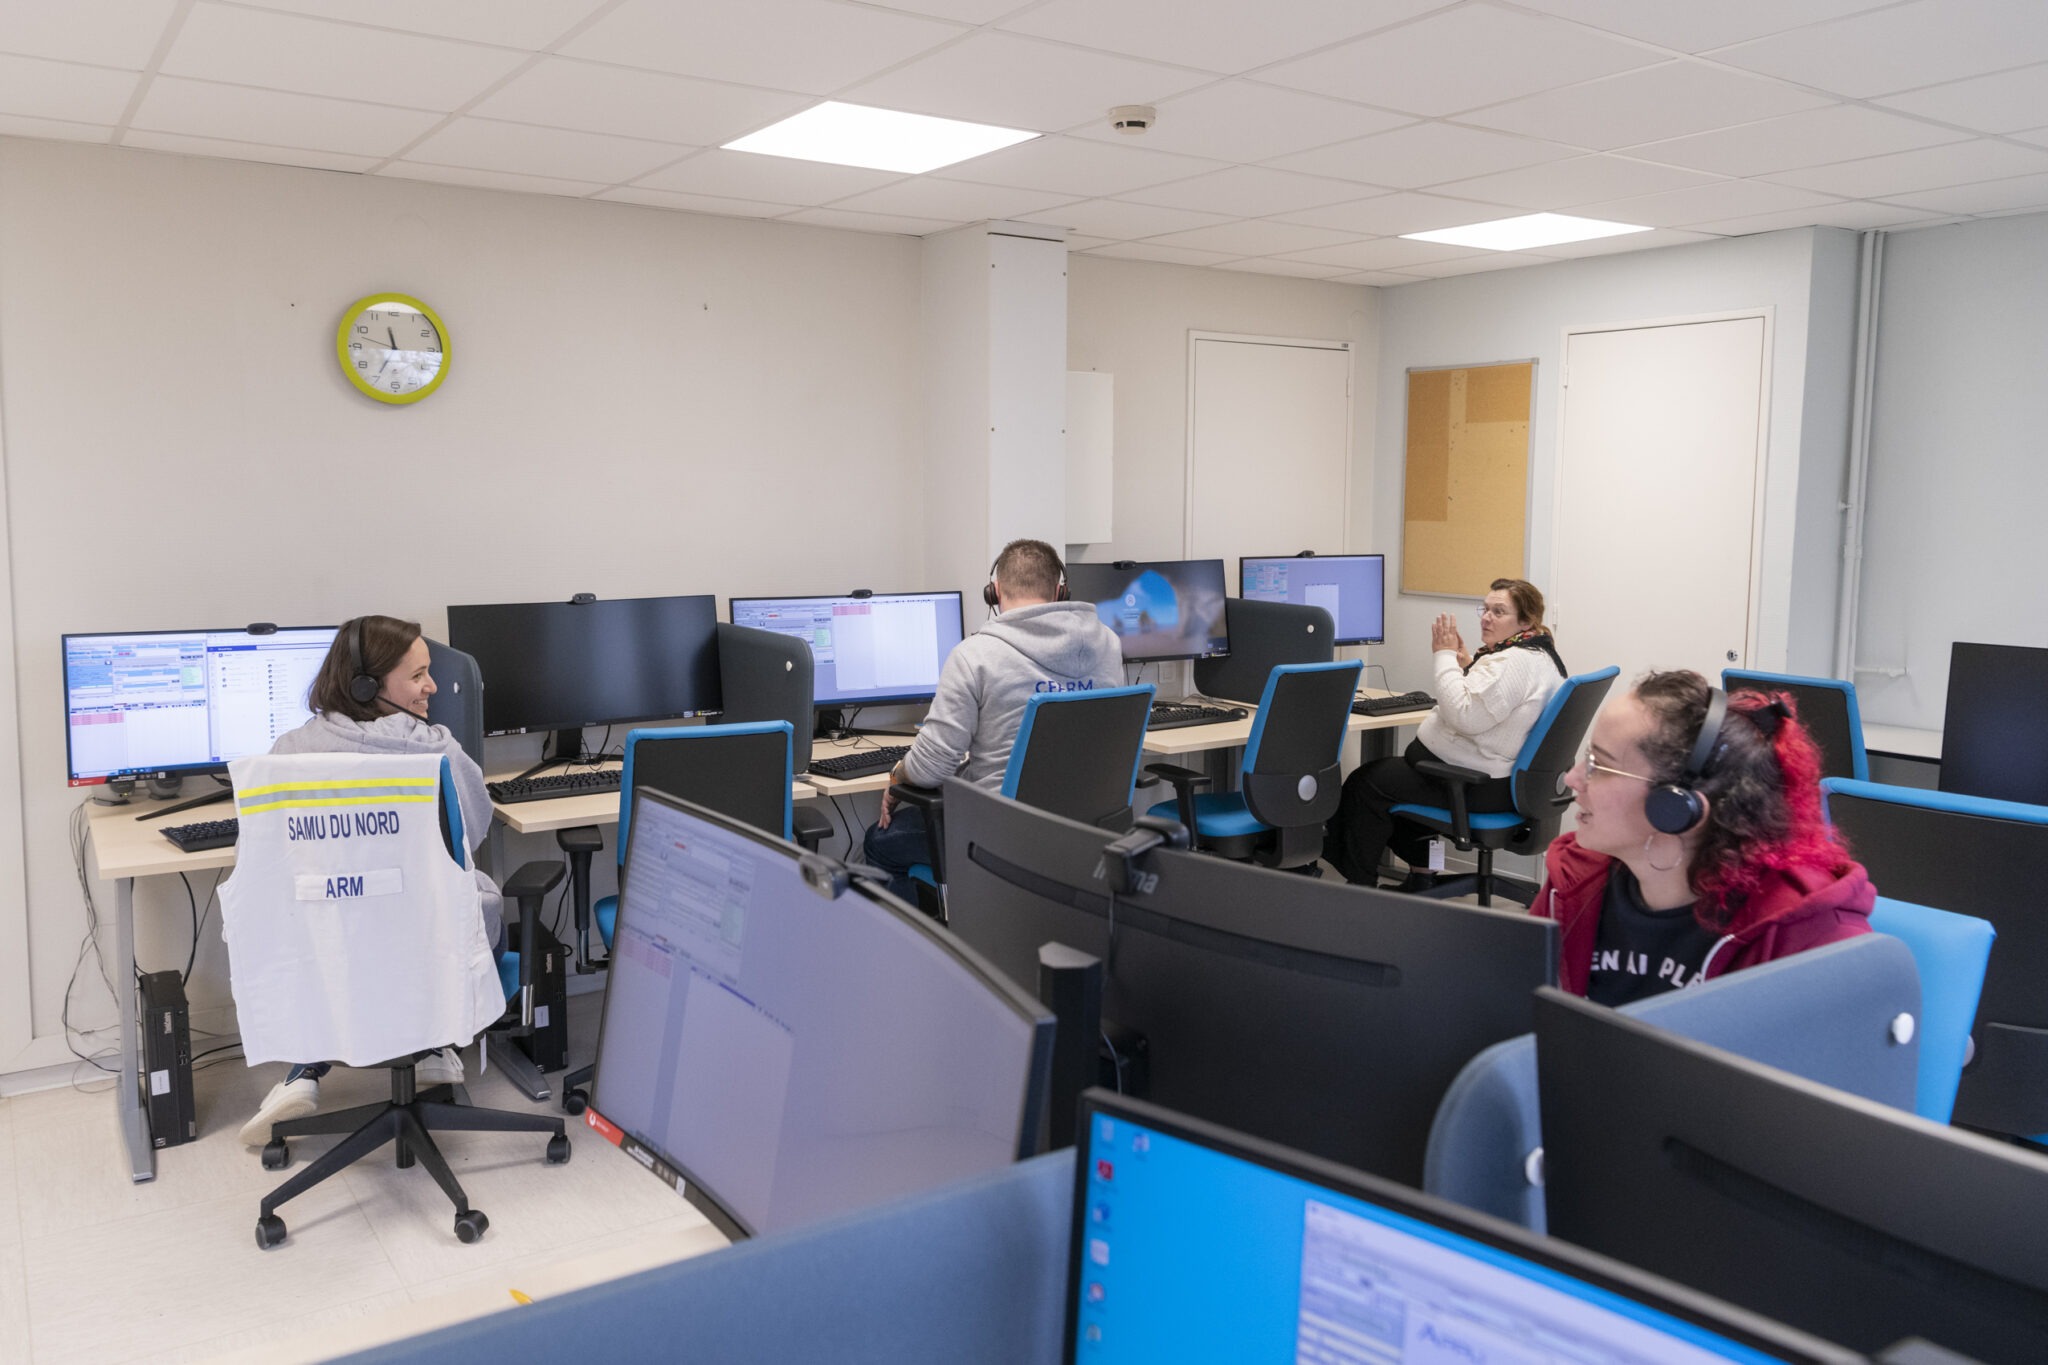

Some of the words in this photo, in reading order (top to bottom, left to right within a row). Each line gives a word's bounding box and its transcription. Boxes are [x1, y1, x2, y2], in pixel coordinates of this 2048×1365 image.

[357, 326, 369, 334] 10
[420, 329, 430, 338] 2
[358, 360, 368, 369] 8
[390, 381, 400, 390] 6
[288, 815, 326, 841] SAMU
[329, 813, 351, 838] DU
[355, 810, 400, 836] NORD
[325, 876, 364, 898] ARM
